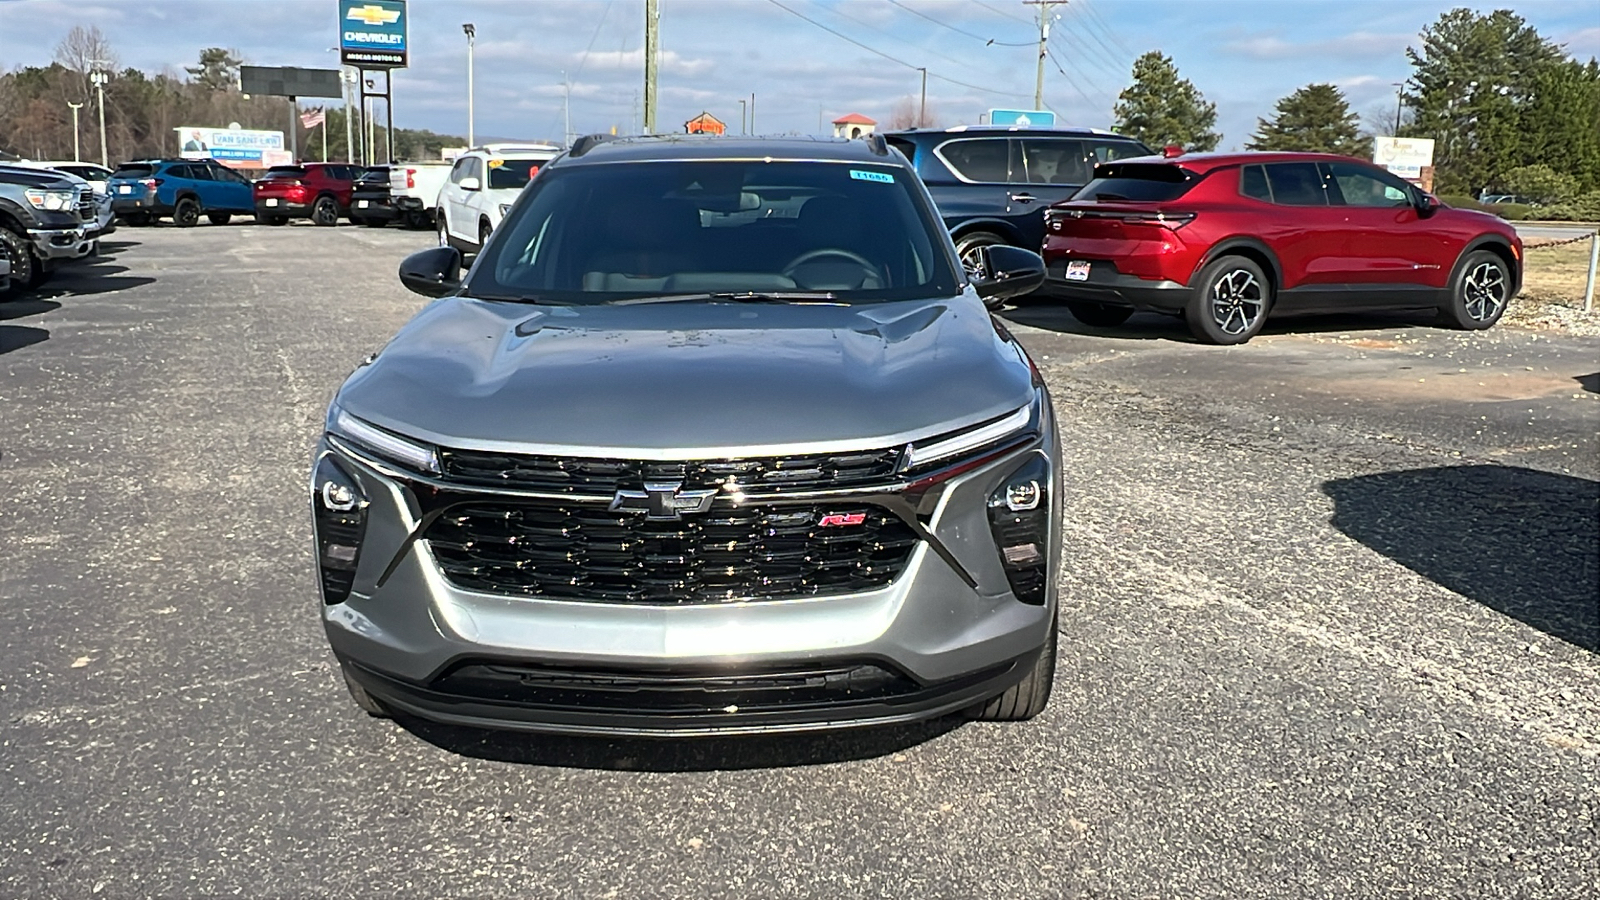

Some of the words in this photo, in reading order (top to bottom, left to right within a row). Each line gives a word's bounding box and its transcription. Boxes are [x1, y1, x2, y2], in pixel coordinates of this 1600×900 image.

[344, 32, 403, 43] CHEVROLET
[216, 135, 234, 143] VAN
[260, 137, 278, 145] LAW
[818, 513, 867, 527] RS
